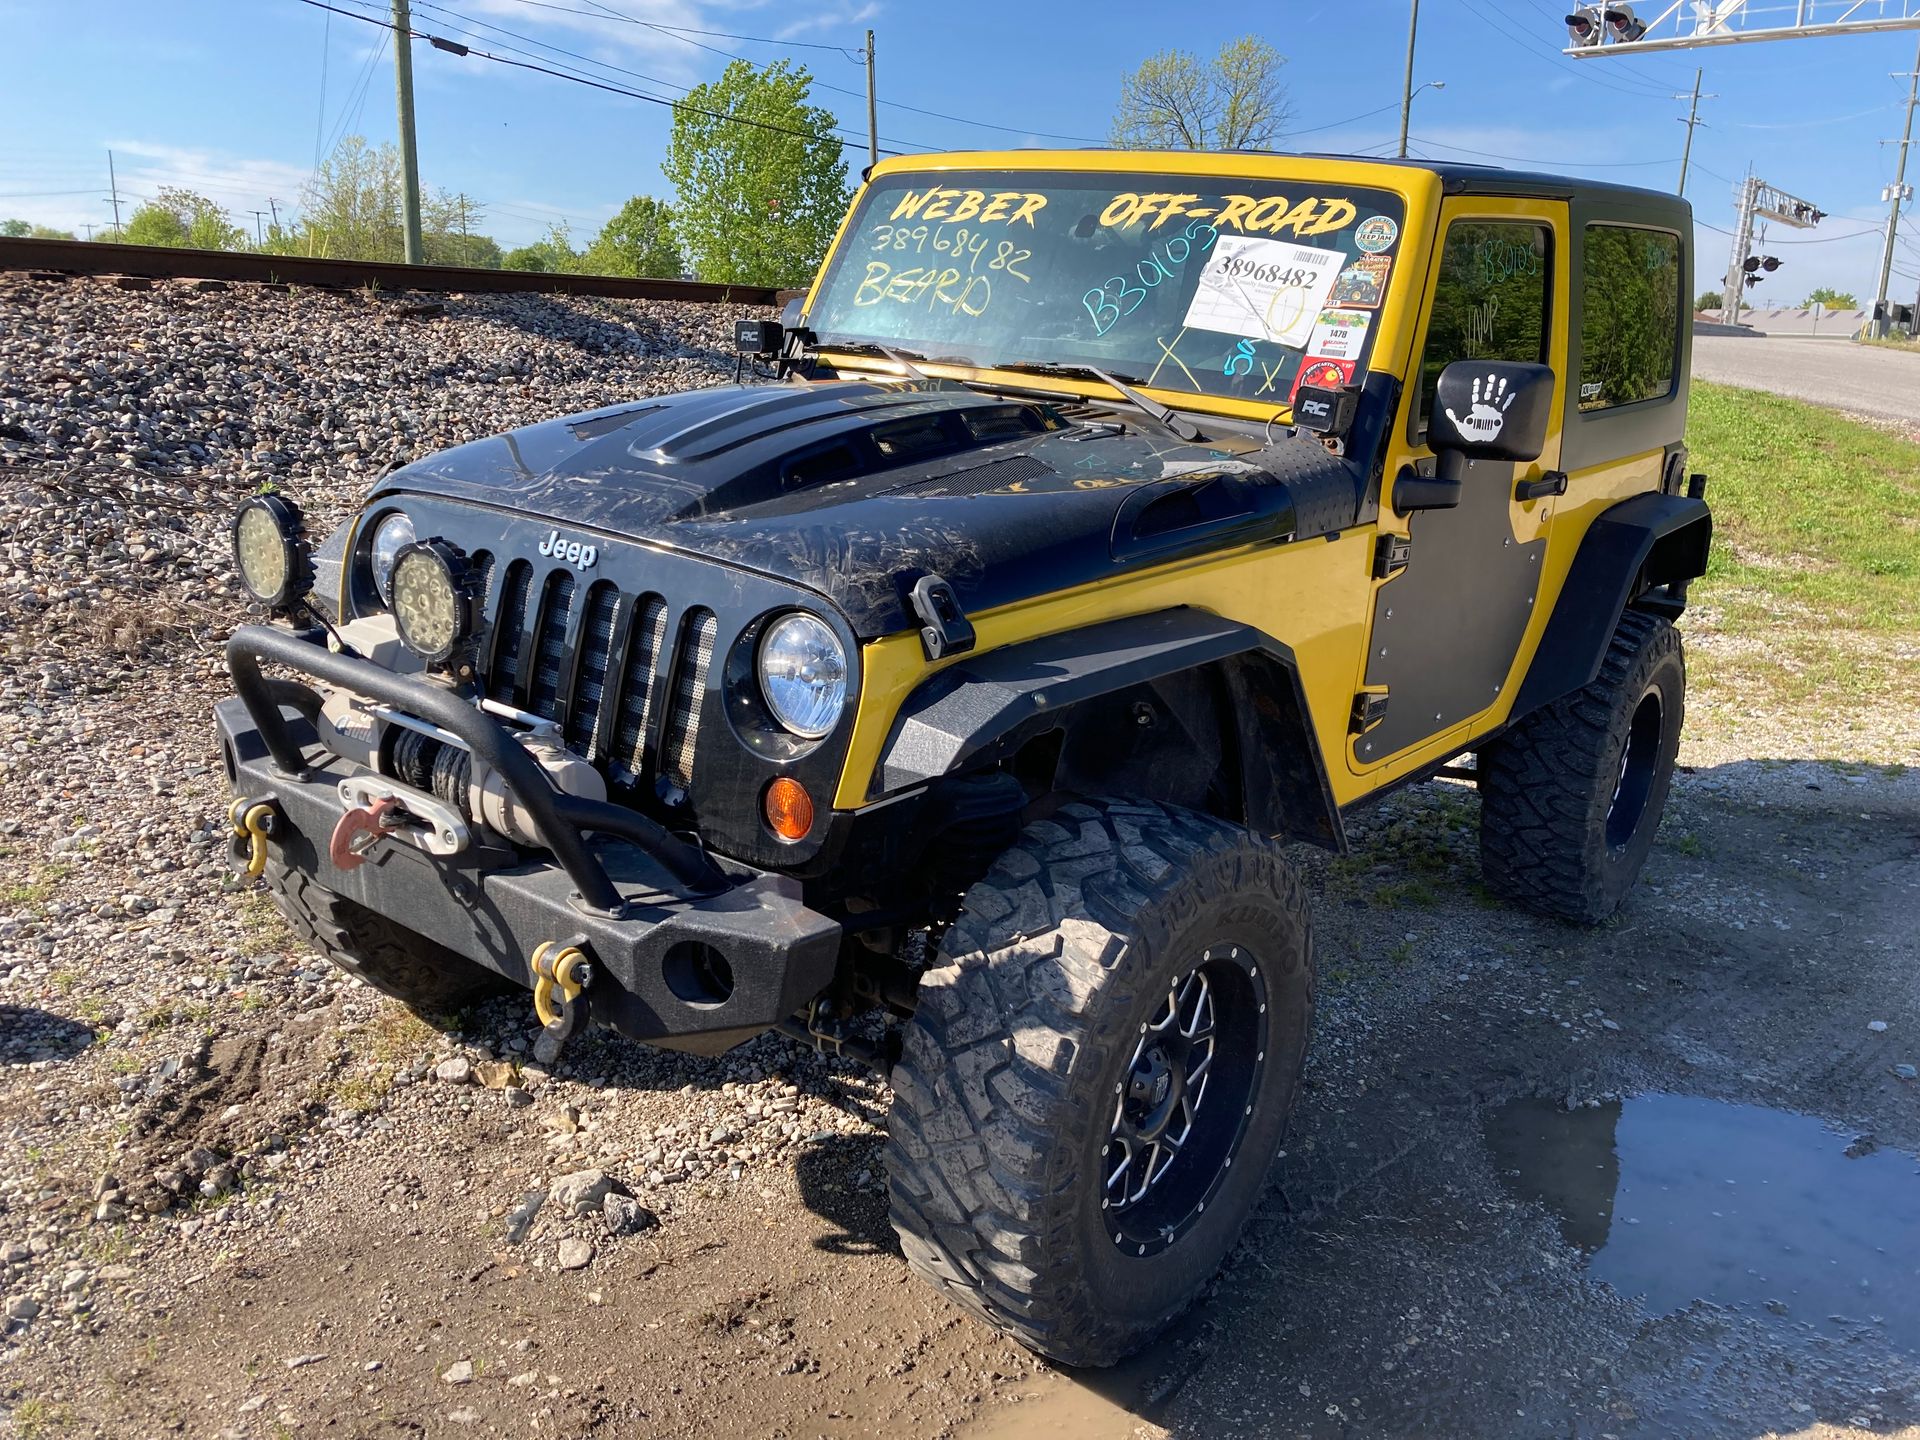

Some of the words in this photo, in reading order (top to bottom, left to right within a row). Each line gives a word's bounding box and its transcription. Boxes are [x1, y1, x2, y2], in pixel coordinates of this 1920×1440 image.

[890, 185, 1047, 229] WEBER
[1100, 191, 1357, 238] OFF-ROAD
[871, 225, 1032, 283] 38968482
[1216, 255, 1318, 290] 38968482
[741, 330, 759, 342] RC
[1330, 329, 1348, 339] 1478
[1301, 399, 1330, 417] RC
[539, 530, 598, 572] Jeep
